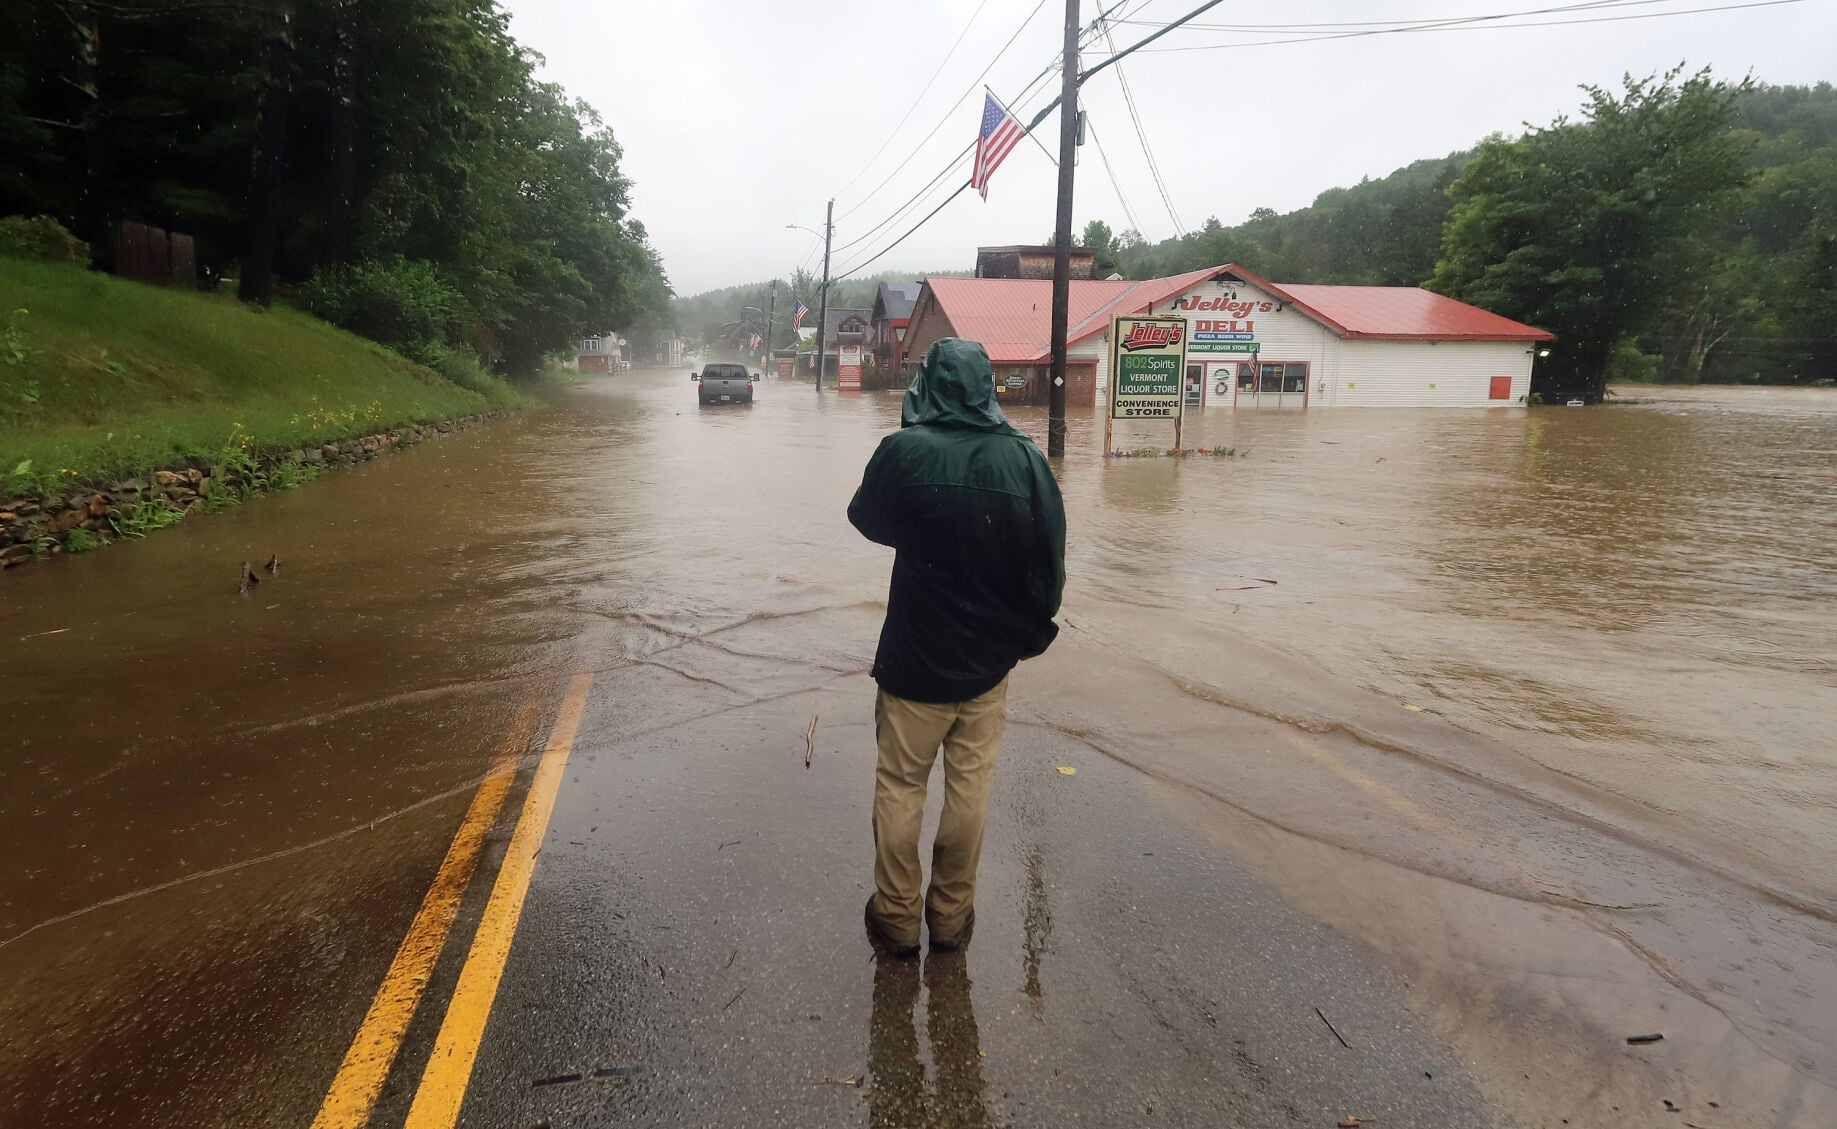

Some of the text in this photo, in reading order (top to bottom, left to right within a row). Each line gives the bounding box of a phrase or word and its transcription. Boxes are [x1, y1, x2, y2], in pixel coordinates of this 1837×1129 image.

[1181, 296, 1273, 318] Jelley's
[1195, 320, 1254, 332] DELI
[1123, 323, 1183, 349] Jelley's
[1129, 374, 1168, 382] VERMONT
[1120, 385, 1177, 393] LIQUOR STORE
